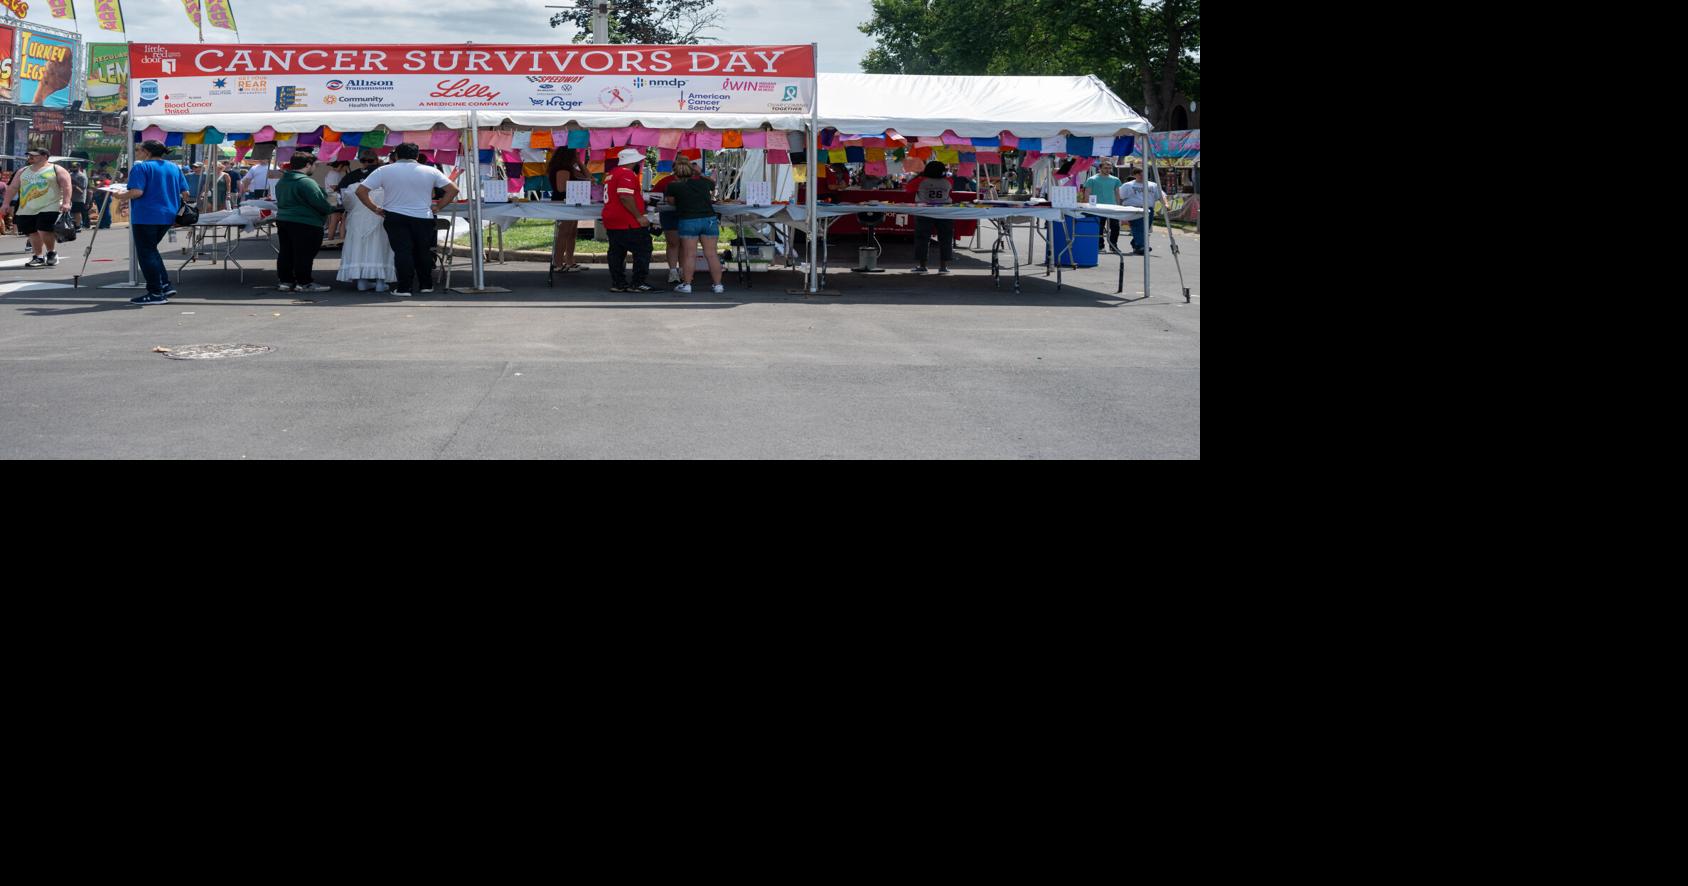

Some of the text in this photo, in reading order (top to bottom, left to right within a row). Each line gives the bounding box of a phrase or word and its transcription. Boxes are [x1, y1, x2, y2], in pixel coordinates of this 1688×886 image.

[21, 31, 66, 62] TURKEY
[144, 45, 165, 53] little
[20, 54, 47, 80] LEGS
[195, 49, 785, 74] CANCER SURVIVORS DAY
[538, 75, 585, 83] SPEEDWAY
[649, 78, 686, 88] nmdp
[430, 78, 501, 102] Lilly
[338, 96, 383, 104] Community
[546, 96, 583, 111] Kroger
[929, 190, 943, 199] 26
